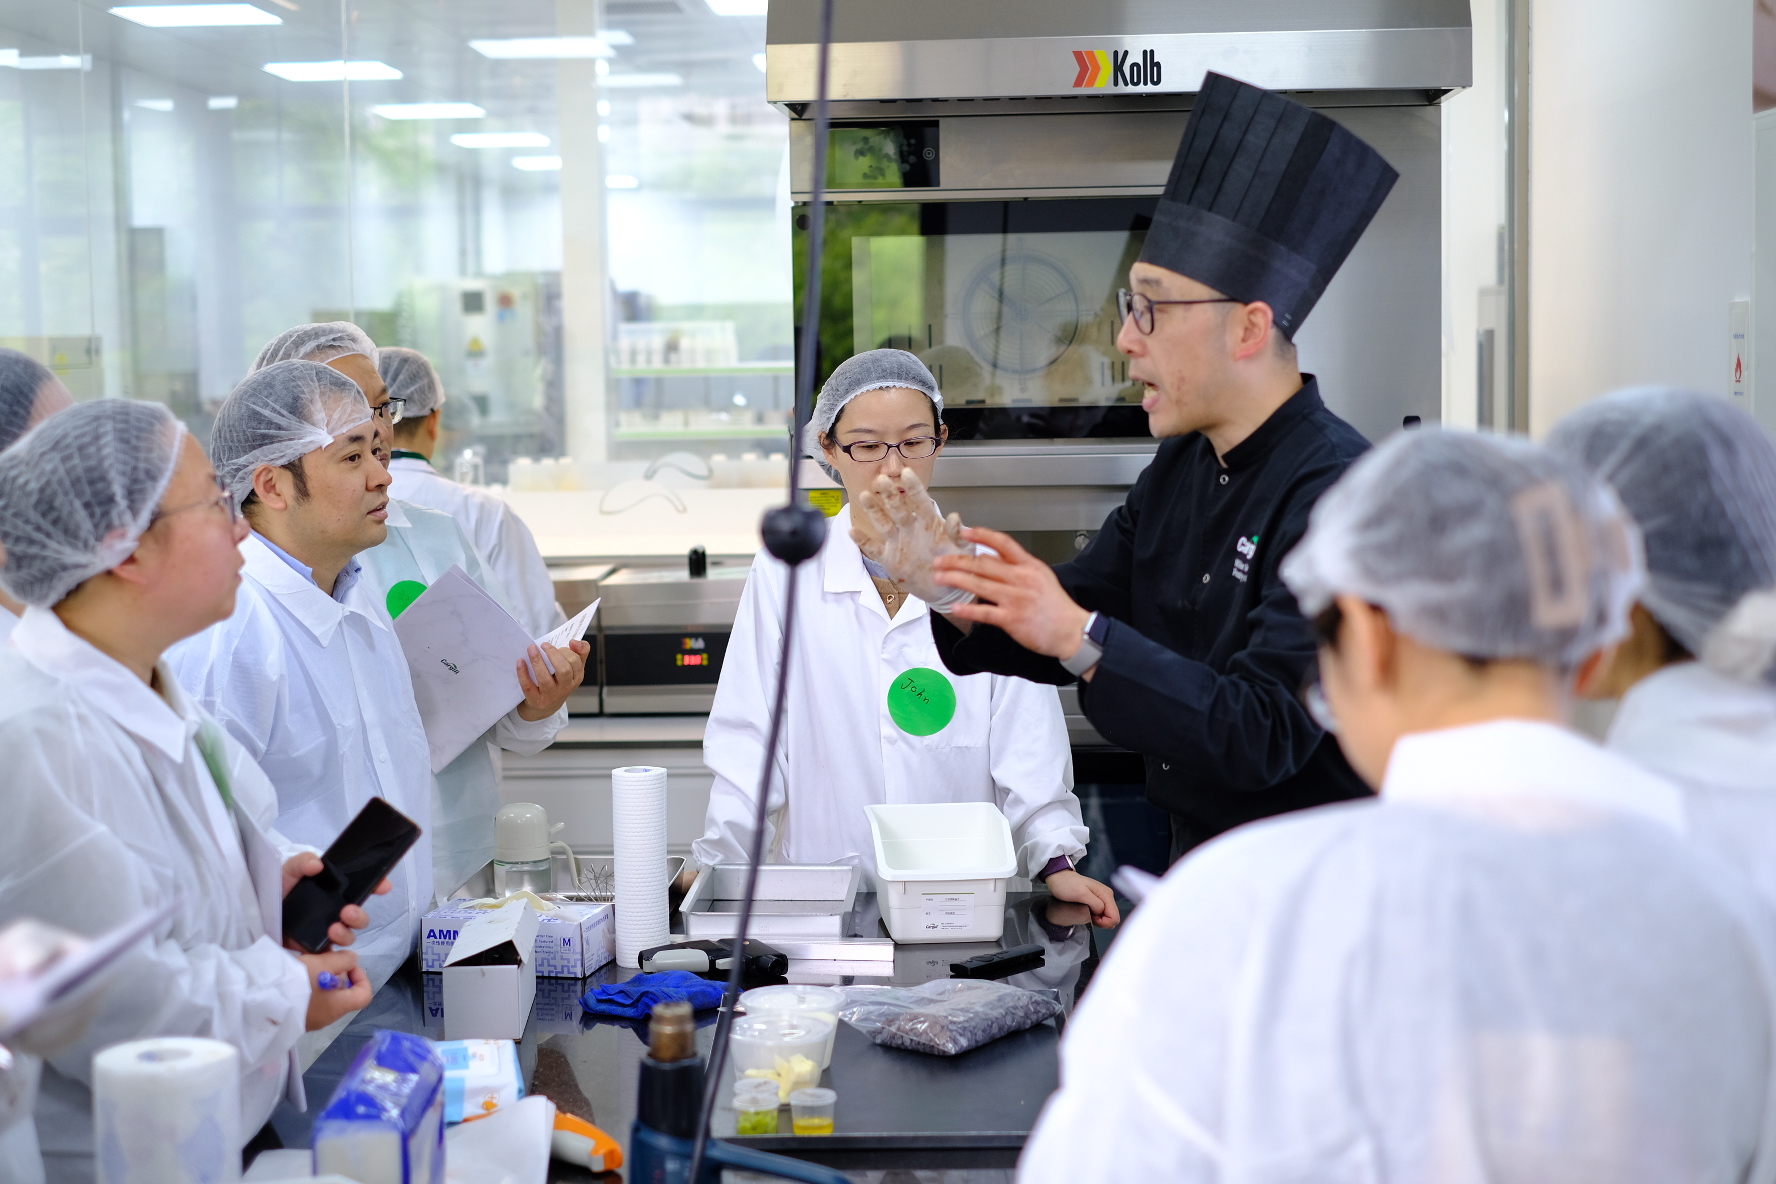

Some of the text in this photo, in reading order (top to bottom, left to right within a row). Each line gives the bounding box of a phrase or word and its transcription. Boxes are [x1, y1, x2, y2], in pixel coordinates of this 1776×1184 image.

[1113, 49, 1162, 87] Kolb
[901, 678, 930, 704] John
[562, 937, 571, 947] M
